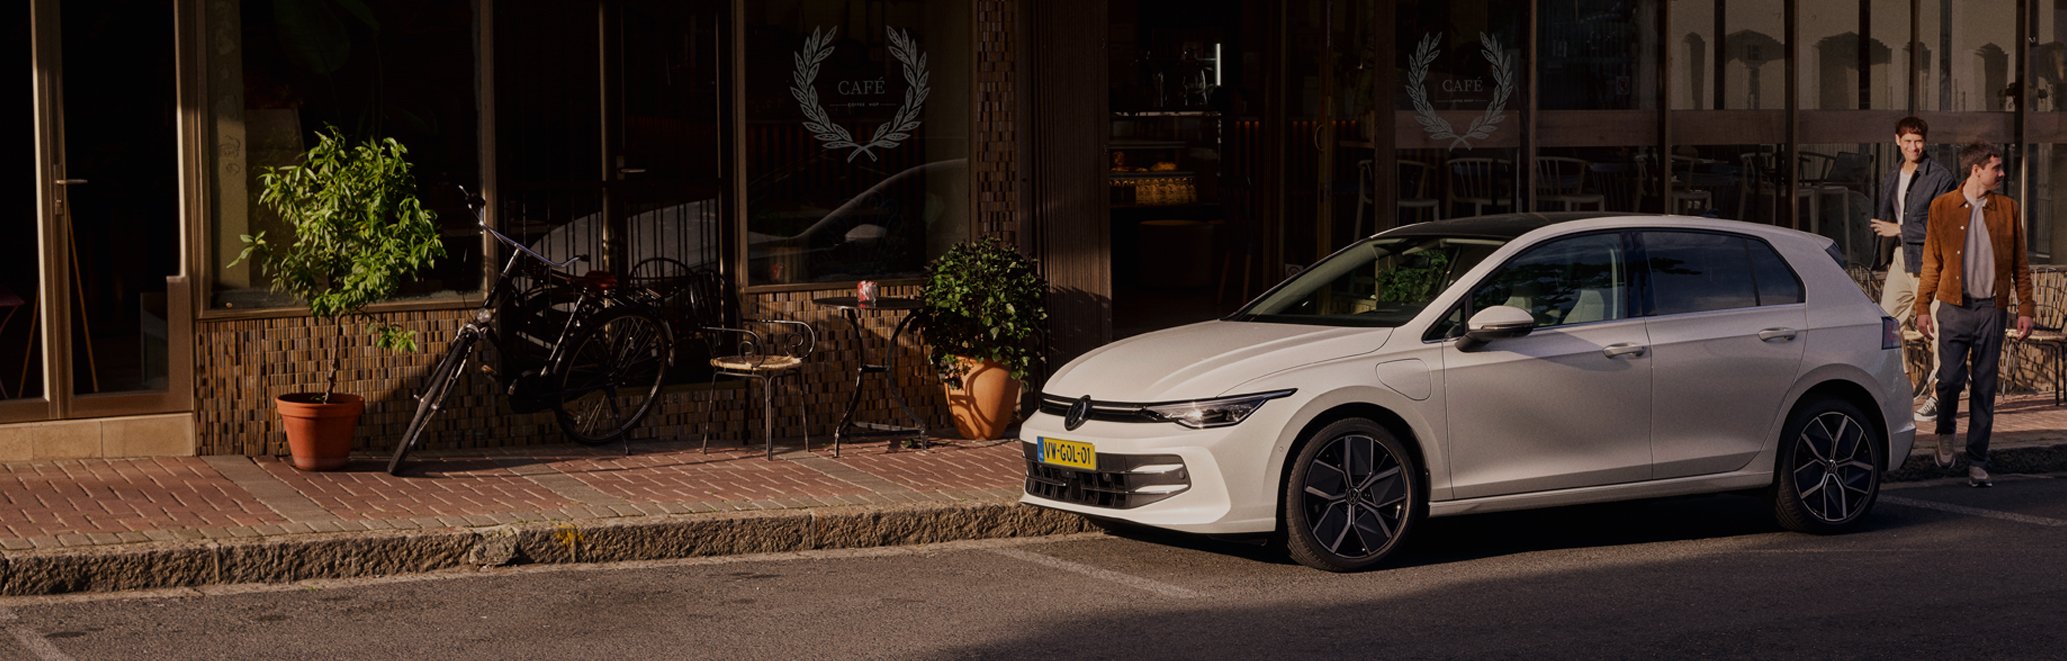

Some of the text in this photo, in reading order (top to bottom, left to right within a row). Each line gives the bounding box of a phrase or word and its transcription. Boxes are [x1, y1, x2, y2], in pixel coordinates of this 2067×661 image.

[837, 76, 886, 96] CAFÉ
[1442, 76, 1483, 93] CAFÉ
[1044, 441, 1091, 465] VW-GOL-01
